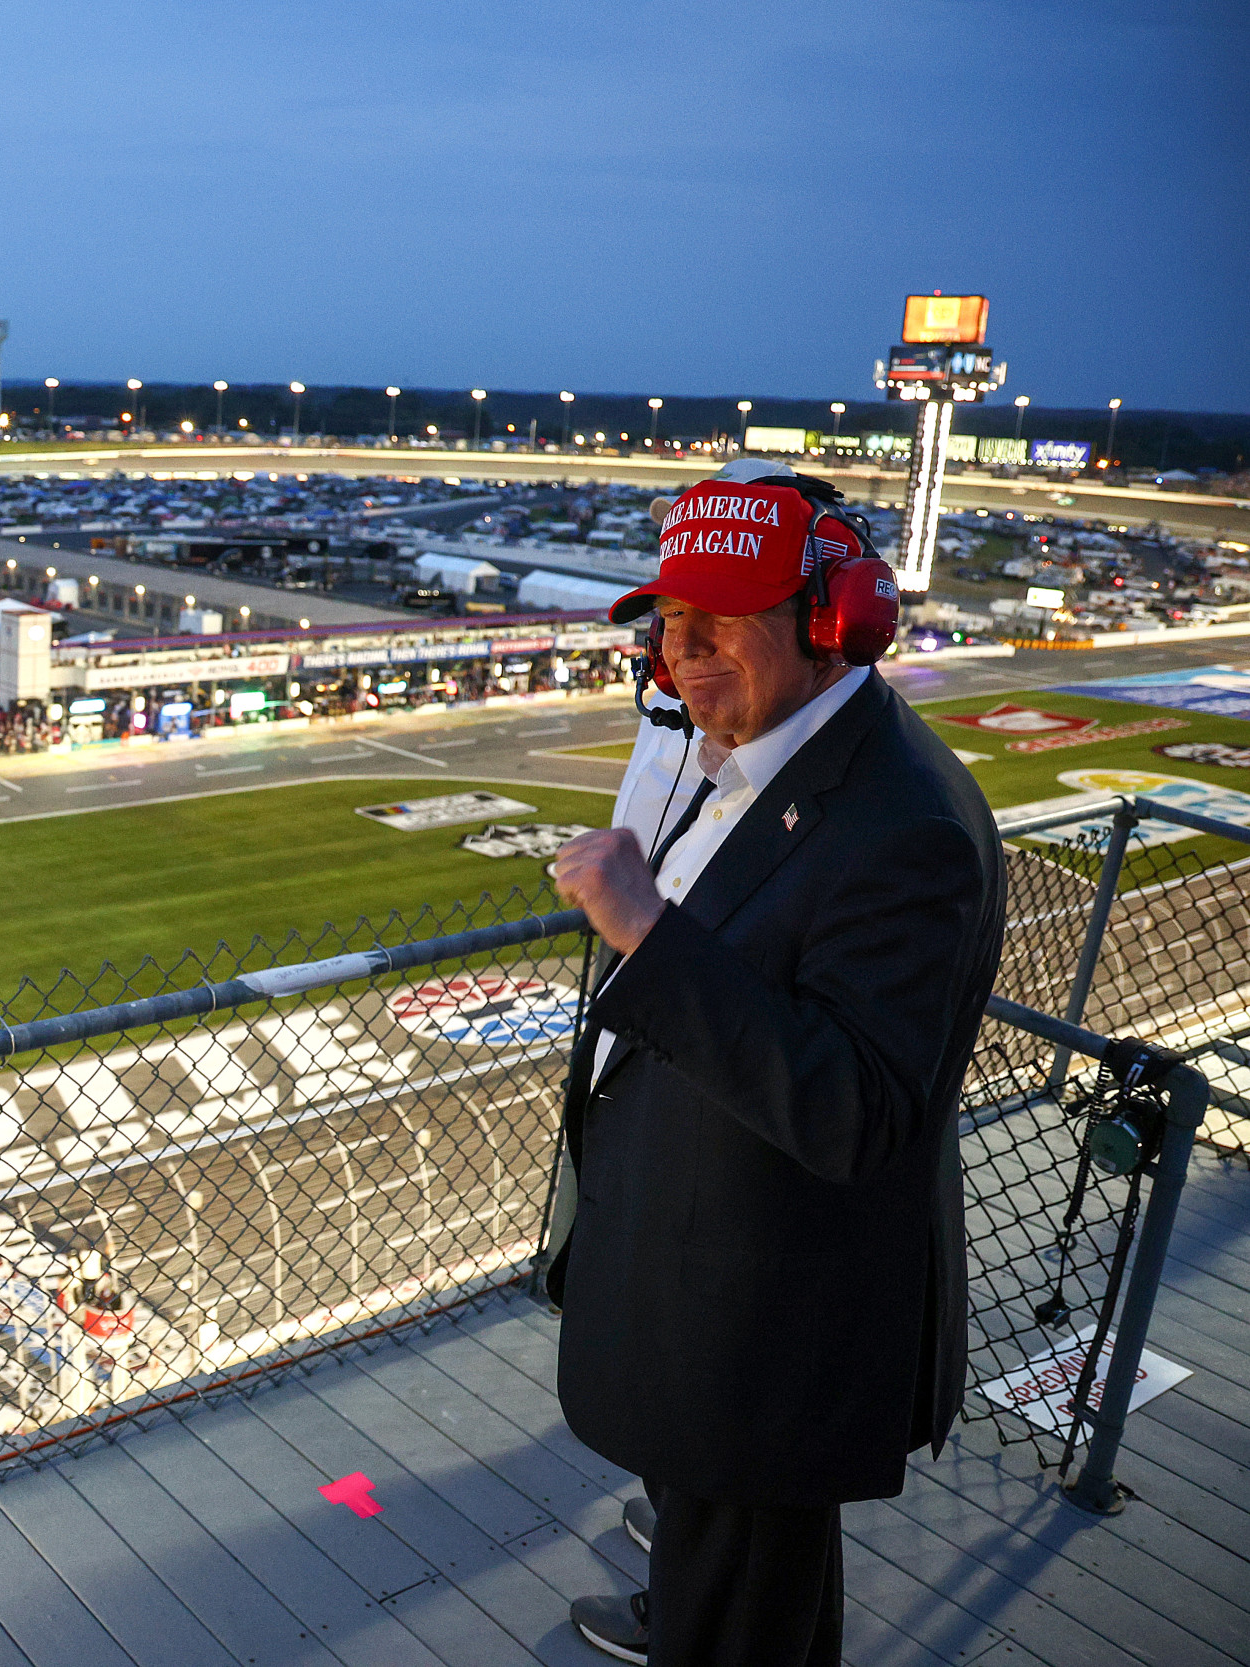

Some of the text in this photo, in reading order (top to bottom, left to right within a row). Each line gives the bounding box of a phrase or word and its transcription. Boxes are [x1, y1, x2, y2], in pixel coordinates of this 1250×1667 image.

[1034, 440, 1087, 462] xfinity
[683, 496, 780, 527] AMERICA
[690, 530, 764, 560] AGAIN
[246, 658, 280, 672] 400
